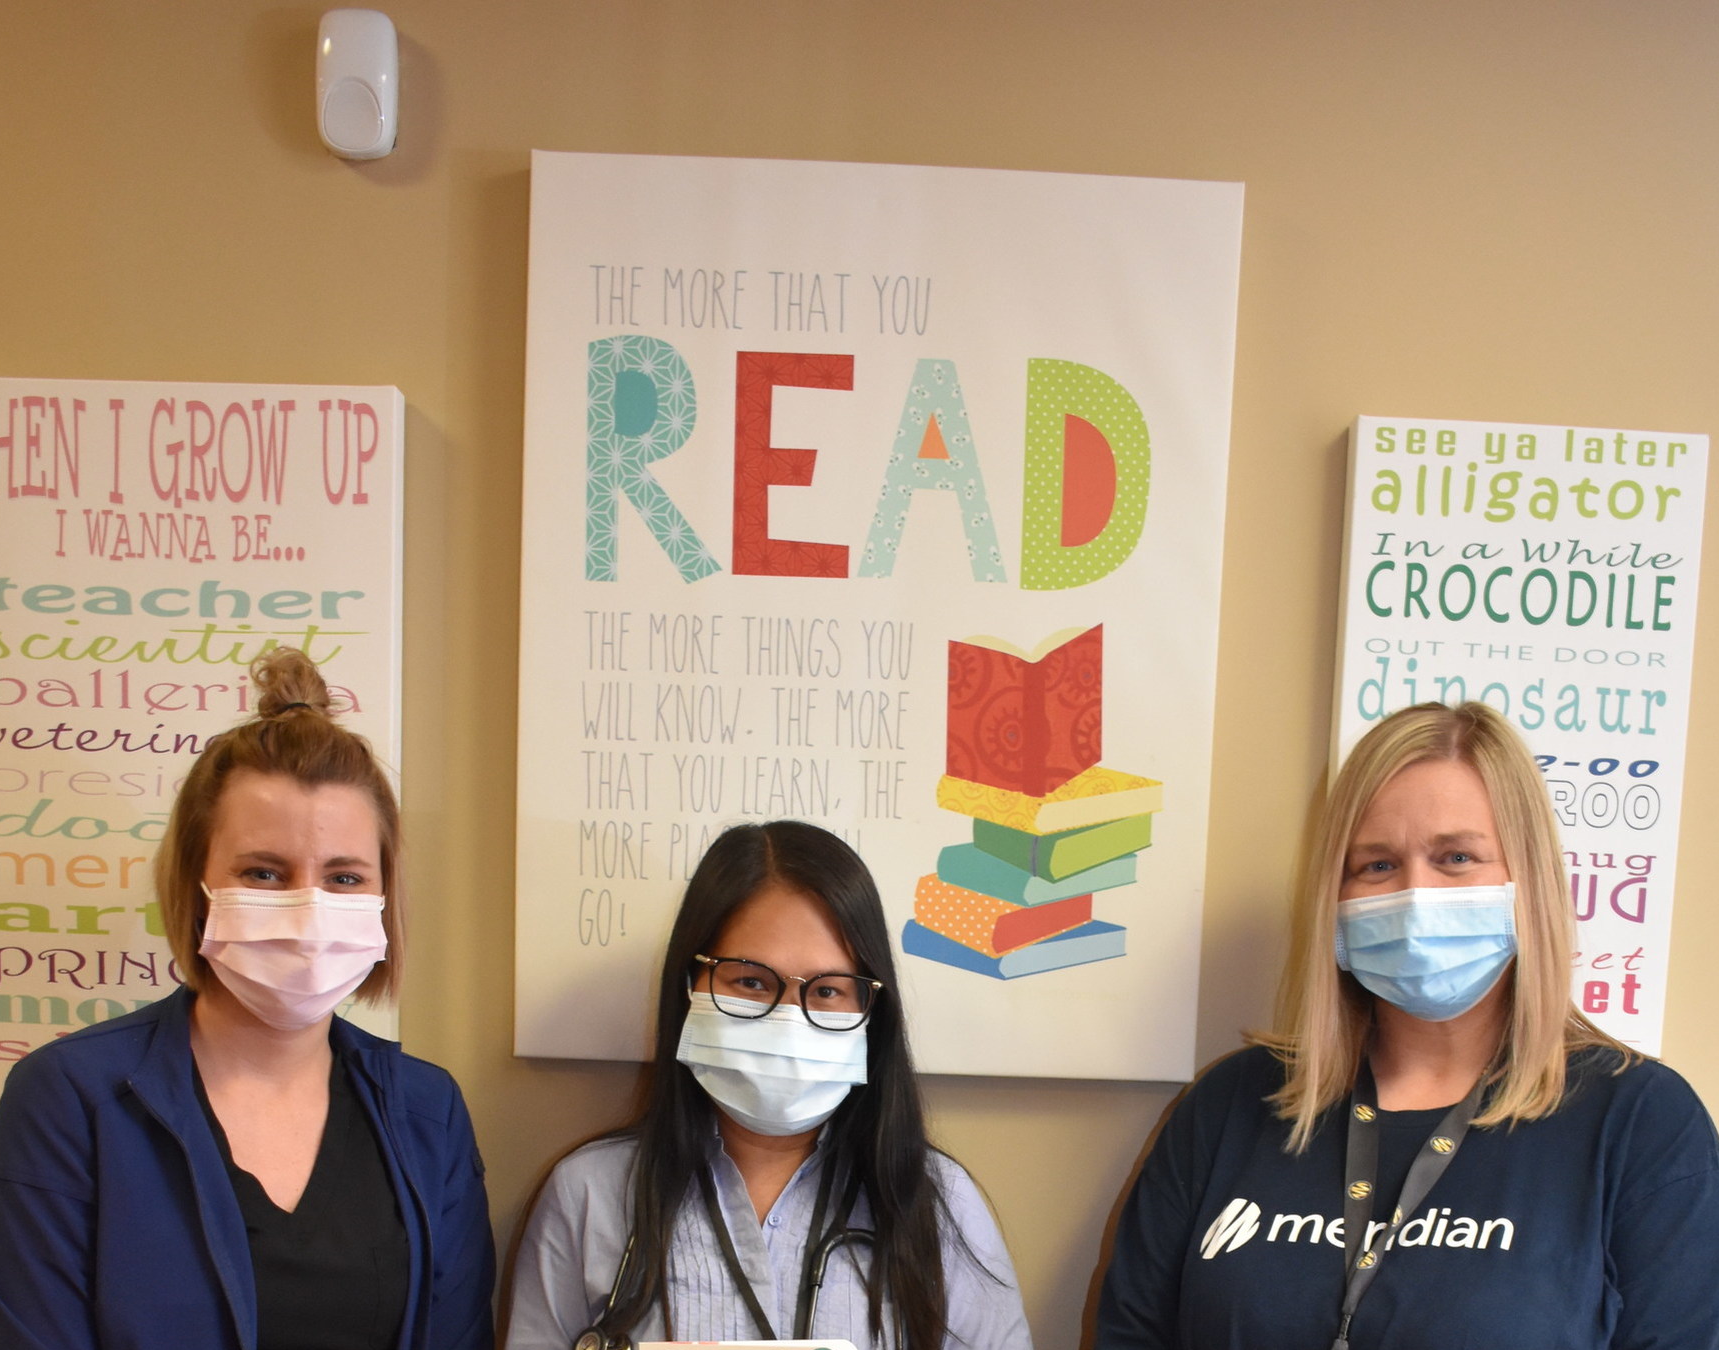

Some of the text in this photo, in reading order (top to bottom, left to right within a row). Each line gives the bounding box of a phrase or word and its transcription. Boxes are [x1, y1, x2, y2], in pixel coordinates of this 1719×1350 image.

[589, 264, 931, 336] THE MORE THAT YOU
[109, 399, 124, 503] I
[149, 397, 295, 508] GROW
[319, 399, 379, 505] UP
[585, 334, 1151, 591] READ
[1375, 426, 1687, 468] see ya later
[1370, 461, 1682, 523] alligator
[55, 509, 305, 563] I WANNA BE...
[1370, 532, 1445, 557] In
[1461, 543, 1504, 560] a
[1365, 560, 1676, 632] CROCODILE
[584, 611, 914, 681] THE MORE THINGS YOU
[1364, 638, 1667, 668] OUT THE DOOR
[582, 681, 637, 741] WILL
[771, 687, 819, 747] THE
[835, 689, 910, 751] MORE
[1357, 656, 1667, 736] dinosaur
[581, 750, 907, 820] THAT YOU LEARN, THE
[579, 819, 653, 880] MORE
[578, 888, 626, 947] GO!
